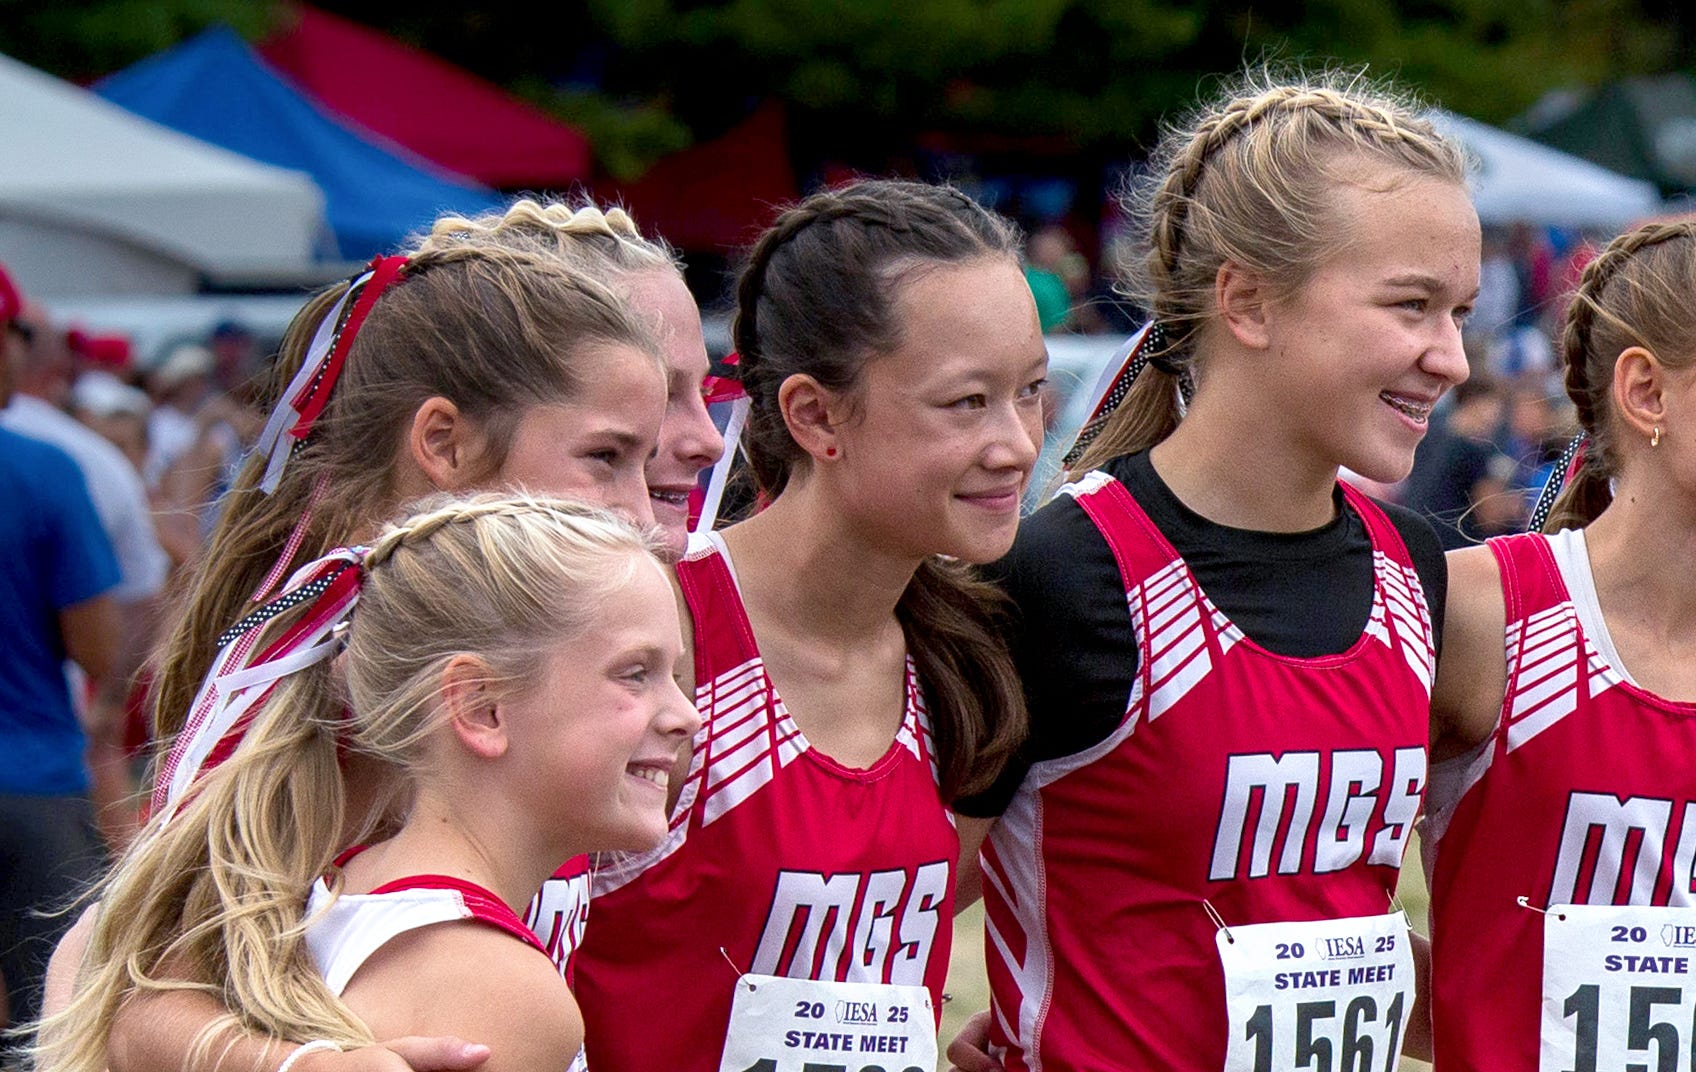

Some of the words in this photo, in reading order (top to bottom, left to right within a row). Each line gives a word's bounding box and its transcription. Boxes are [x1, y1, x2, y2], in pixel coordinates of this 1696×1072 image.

[1208, 746, 1427, 881] MGS
[749, 860, 950, 987] MGS
[1611, 926, 1647, 943] 20
[1275, 943, 1305, 960] 20
[1325, 936, 1365, 956] IESA
[1375, 935, 1395, 953] 25
[1605, 955, 1689, 974] STATE
[1274, 970, 1340, 990] STATE
[1348, 964, 1395, 985] MEET
[794, 1001, 825, 1019] 20
[844, 1002, 878, 1022] IESA
[887, 1006, 909, 1023] 25
[784, 1030, 853, 1051] STATE
[859, 1035, 908, 1053] MEET
